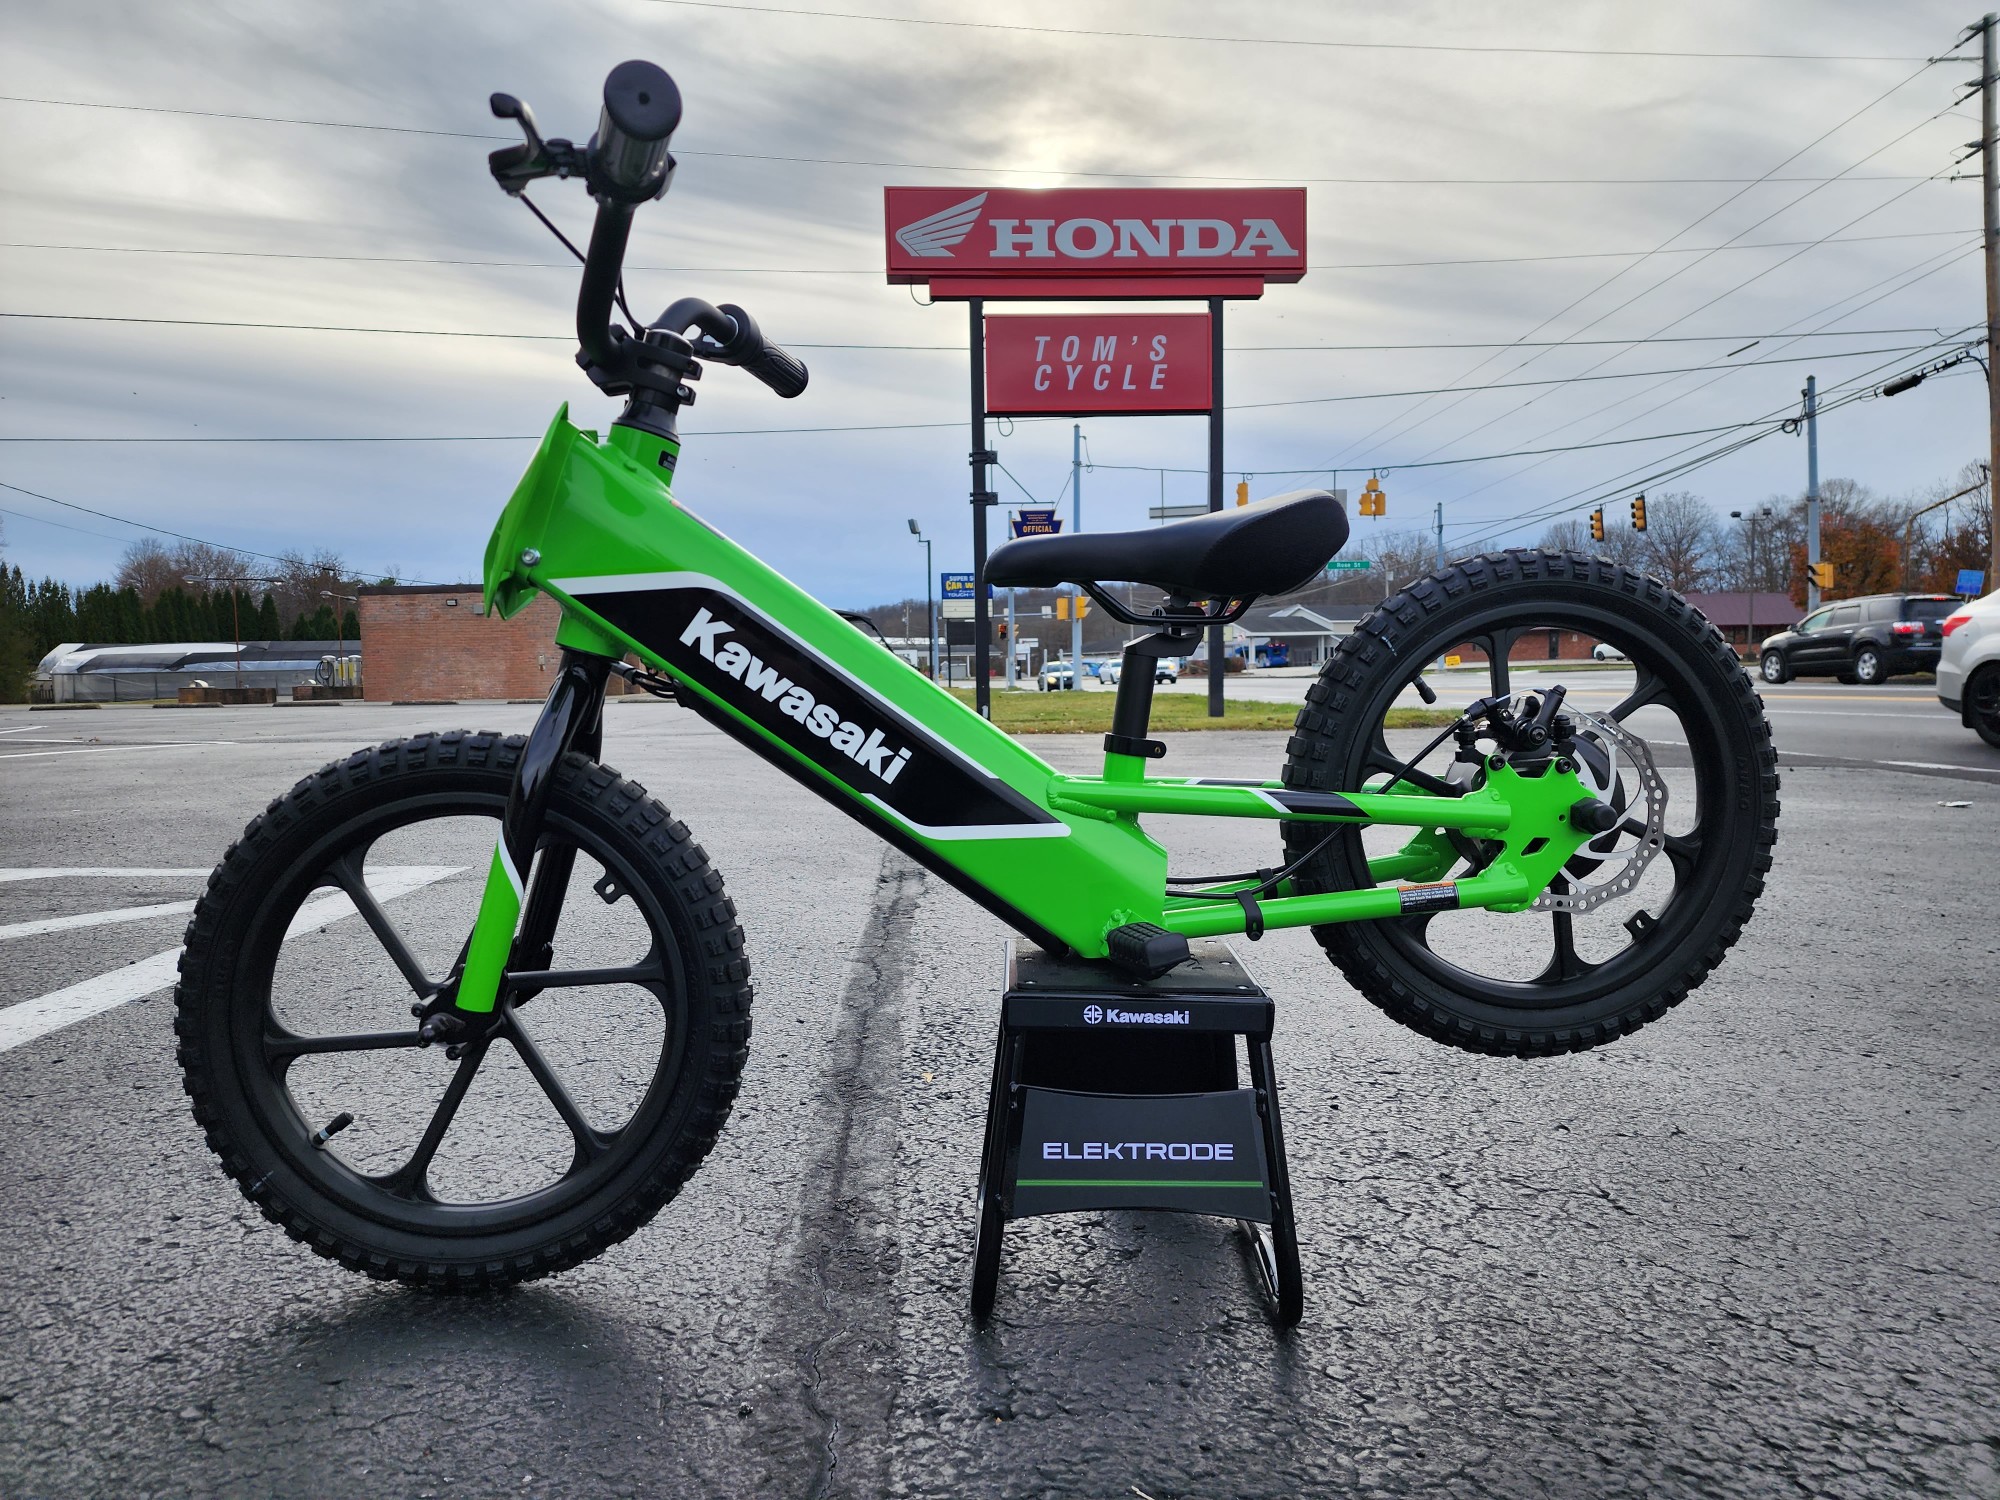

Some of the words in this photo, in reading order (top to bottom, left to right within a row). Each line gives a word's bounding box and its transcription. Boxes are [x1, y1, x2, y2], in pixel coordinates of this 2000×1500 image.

[988, 217, 1299, 259] HONDA
[1034, 334, 1168, 362] TOM'S
[1034, 363, 1168, 391] CYCLE
[1022, 525, 1053, 533] OFFICIAL
[946, 581, 962, 590] CAR
[679, 607, 913, 785] Kawasaki
[1106, 1008, 1190, 1025] Kawasaki
[1042, 1141, 1235, 1161] ELEKTRODE
